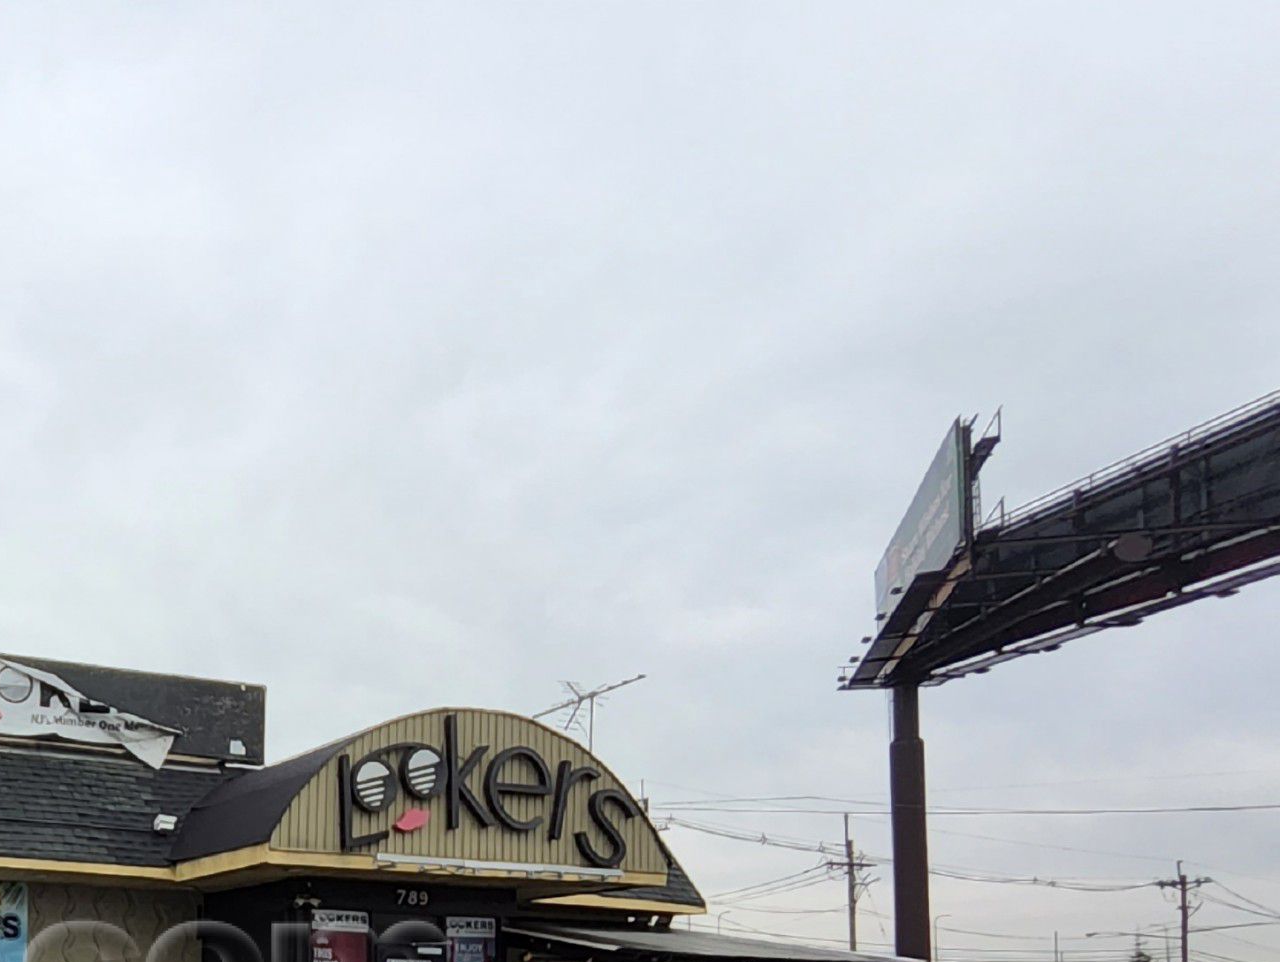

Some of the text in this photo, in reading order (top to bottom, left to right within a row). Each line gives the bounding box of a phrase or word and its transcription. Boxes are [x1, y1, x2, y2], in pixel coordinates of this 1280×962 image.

[53, 715, 96, 728] Number
[99, 720, 121, 732] One
[337, 713, 639, 868] Lookers
[396, 889, 429, 905] 789
